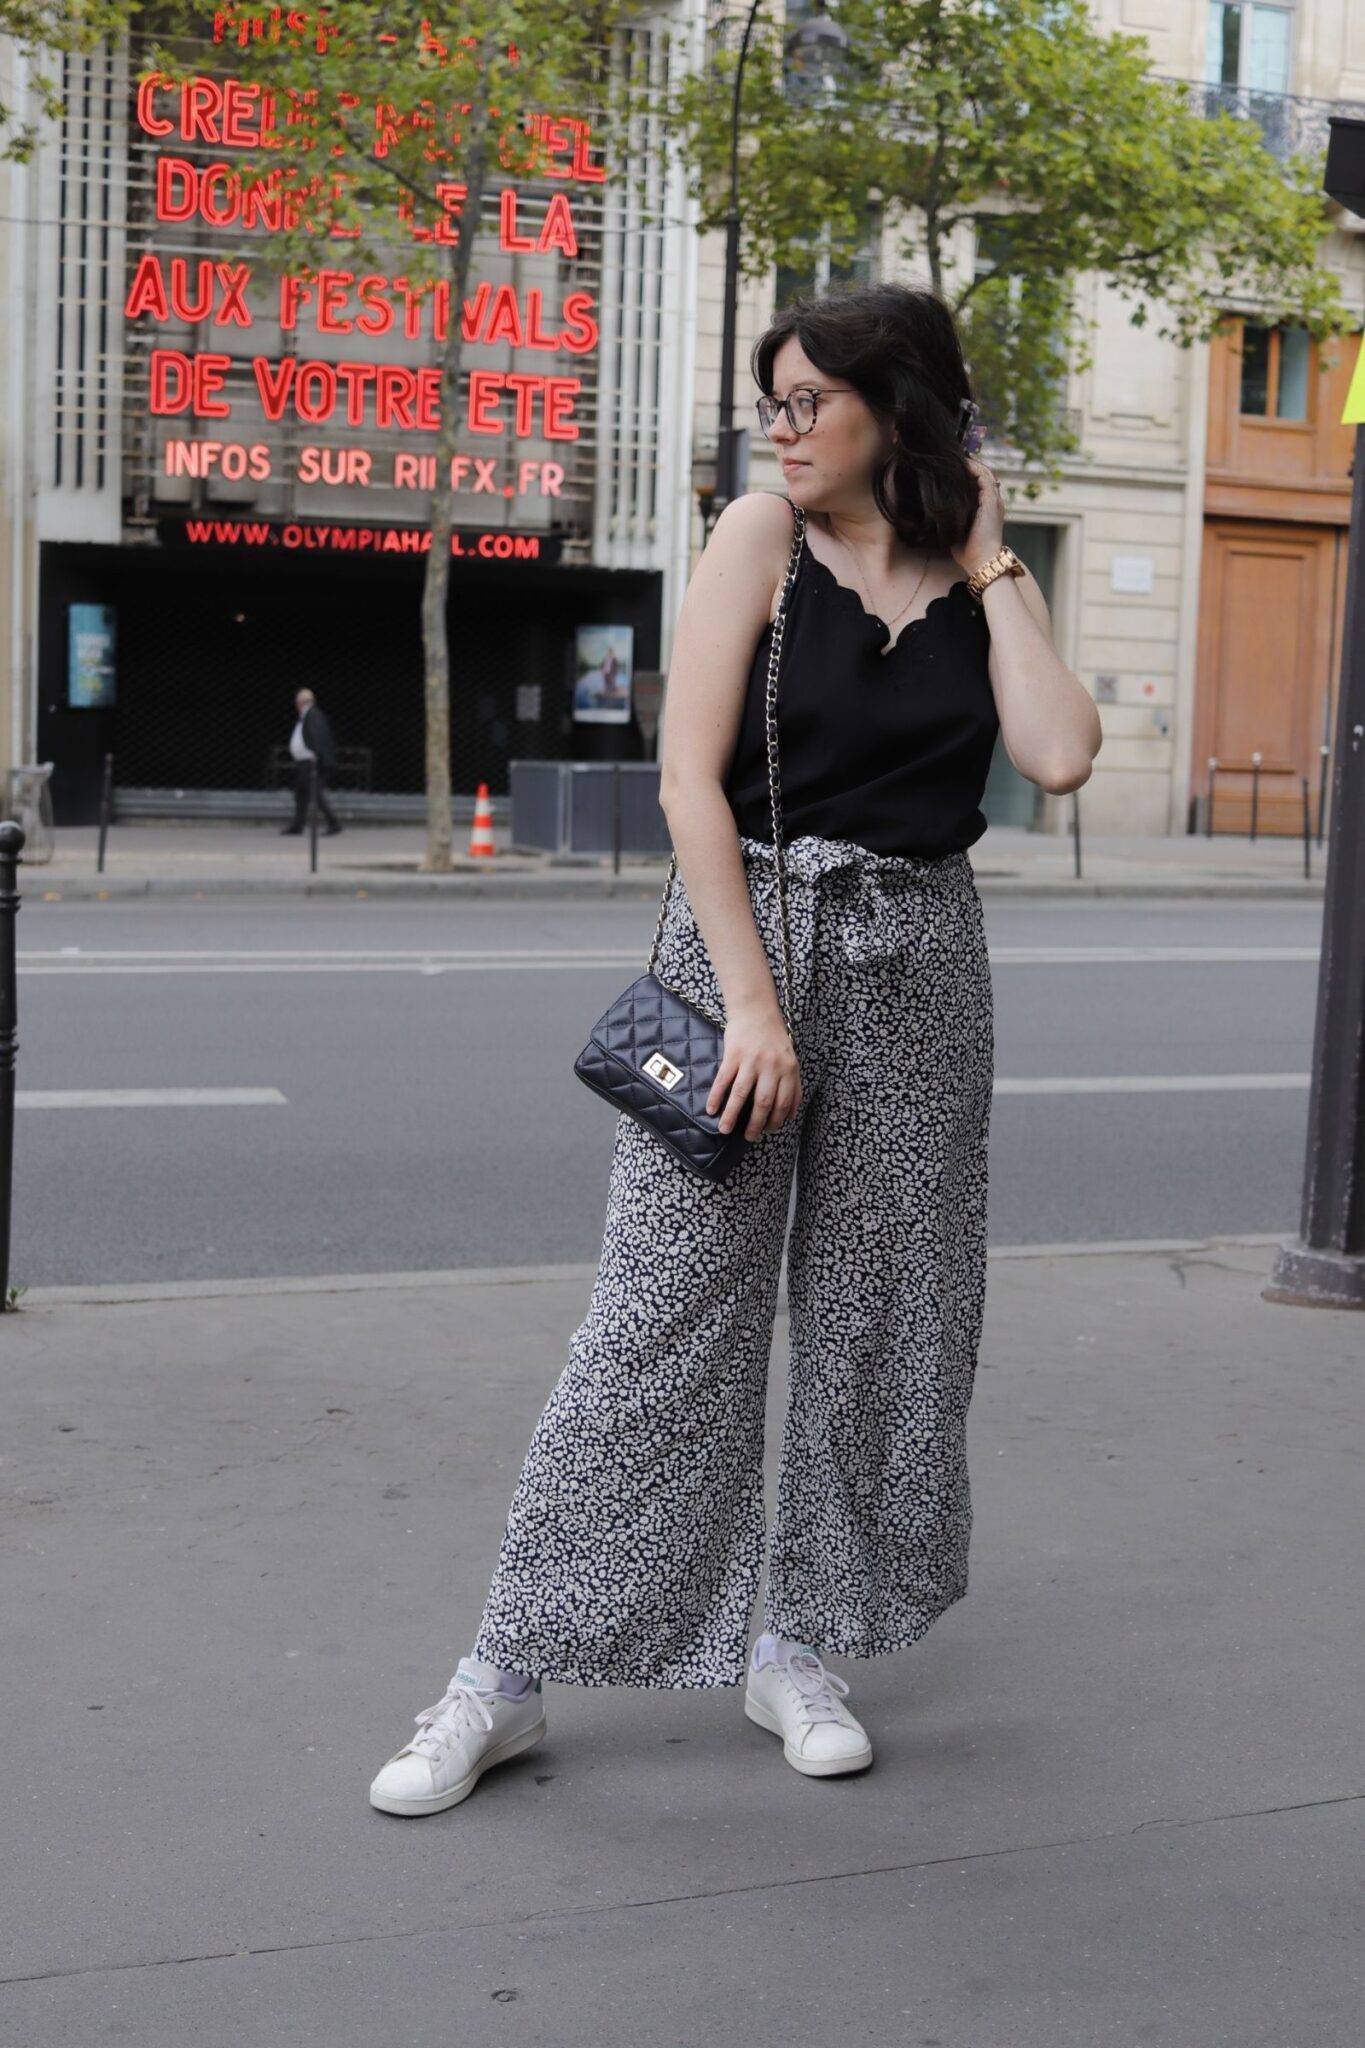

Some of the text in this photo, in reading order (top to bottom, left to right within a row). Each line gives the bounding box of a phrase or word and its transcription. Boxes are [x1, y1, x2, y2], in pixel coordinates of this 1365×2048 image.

[499, 189, 578, 257] LA
[124, 254, 599, 354] AUX FESTIVALS
[149, 349, 582, 440] DE VOTRE ETE
[165, 439, 272, 480] INFOS
[299, 446, 371, 486] SUR
[186, 520, 541, 560] WWW.OLYMPIAHAL.COM
